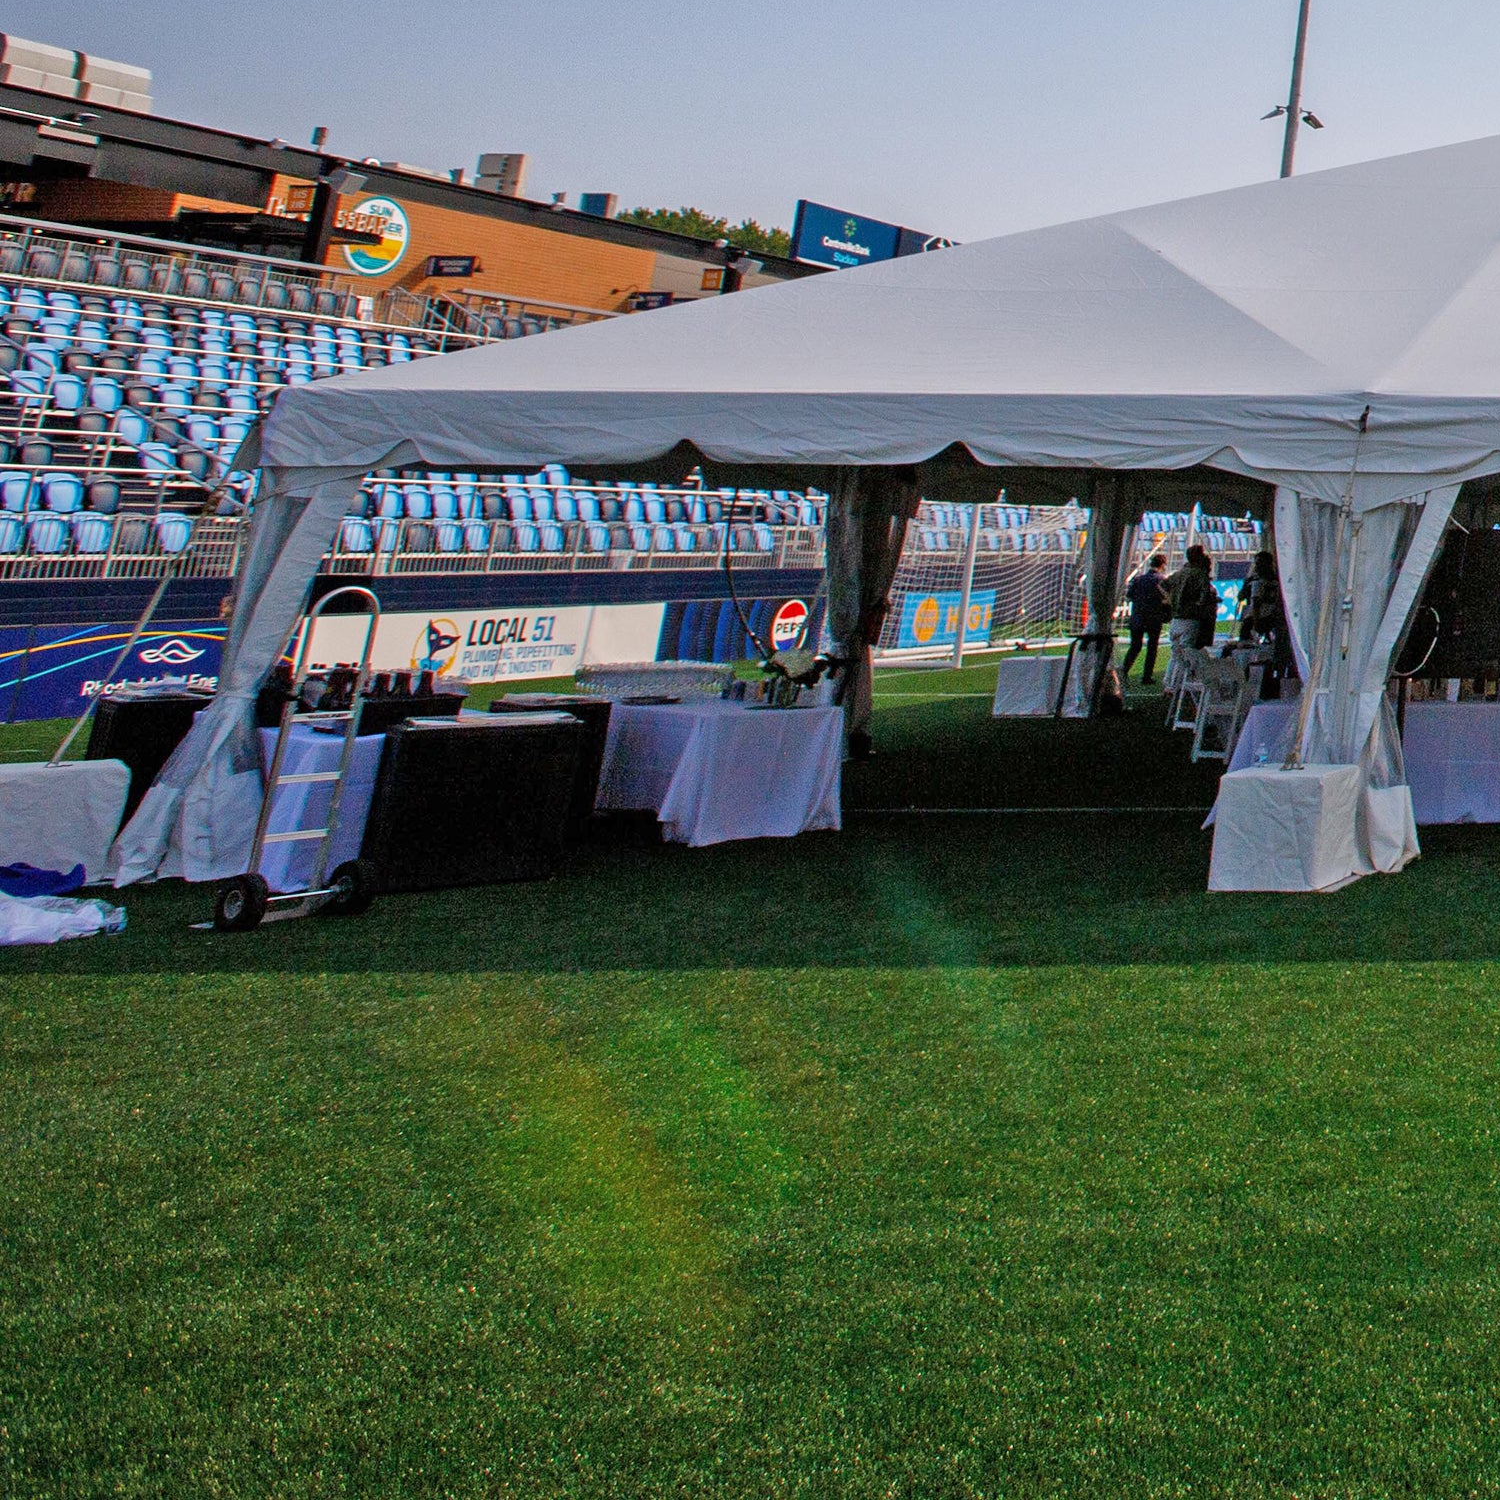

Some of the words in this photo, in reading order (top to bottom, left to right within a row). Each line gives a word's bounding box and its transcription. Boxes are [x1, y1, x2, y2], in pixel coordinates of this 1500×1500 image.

[370, 204, 393, 217] SUN
[467, 617, 527, 645] LOCAL
[532, 616, 556, 641] 51
[517, 644, 576, 657] PIPEFITTING
[461, 665, 480, 678] AND
[508, 660, 553, 674] INDUSTRY
[81, 678, 127, 695] Rhod
[188, 674, 217, 690] Ene
